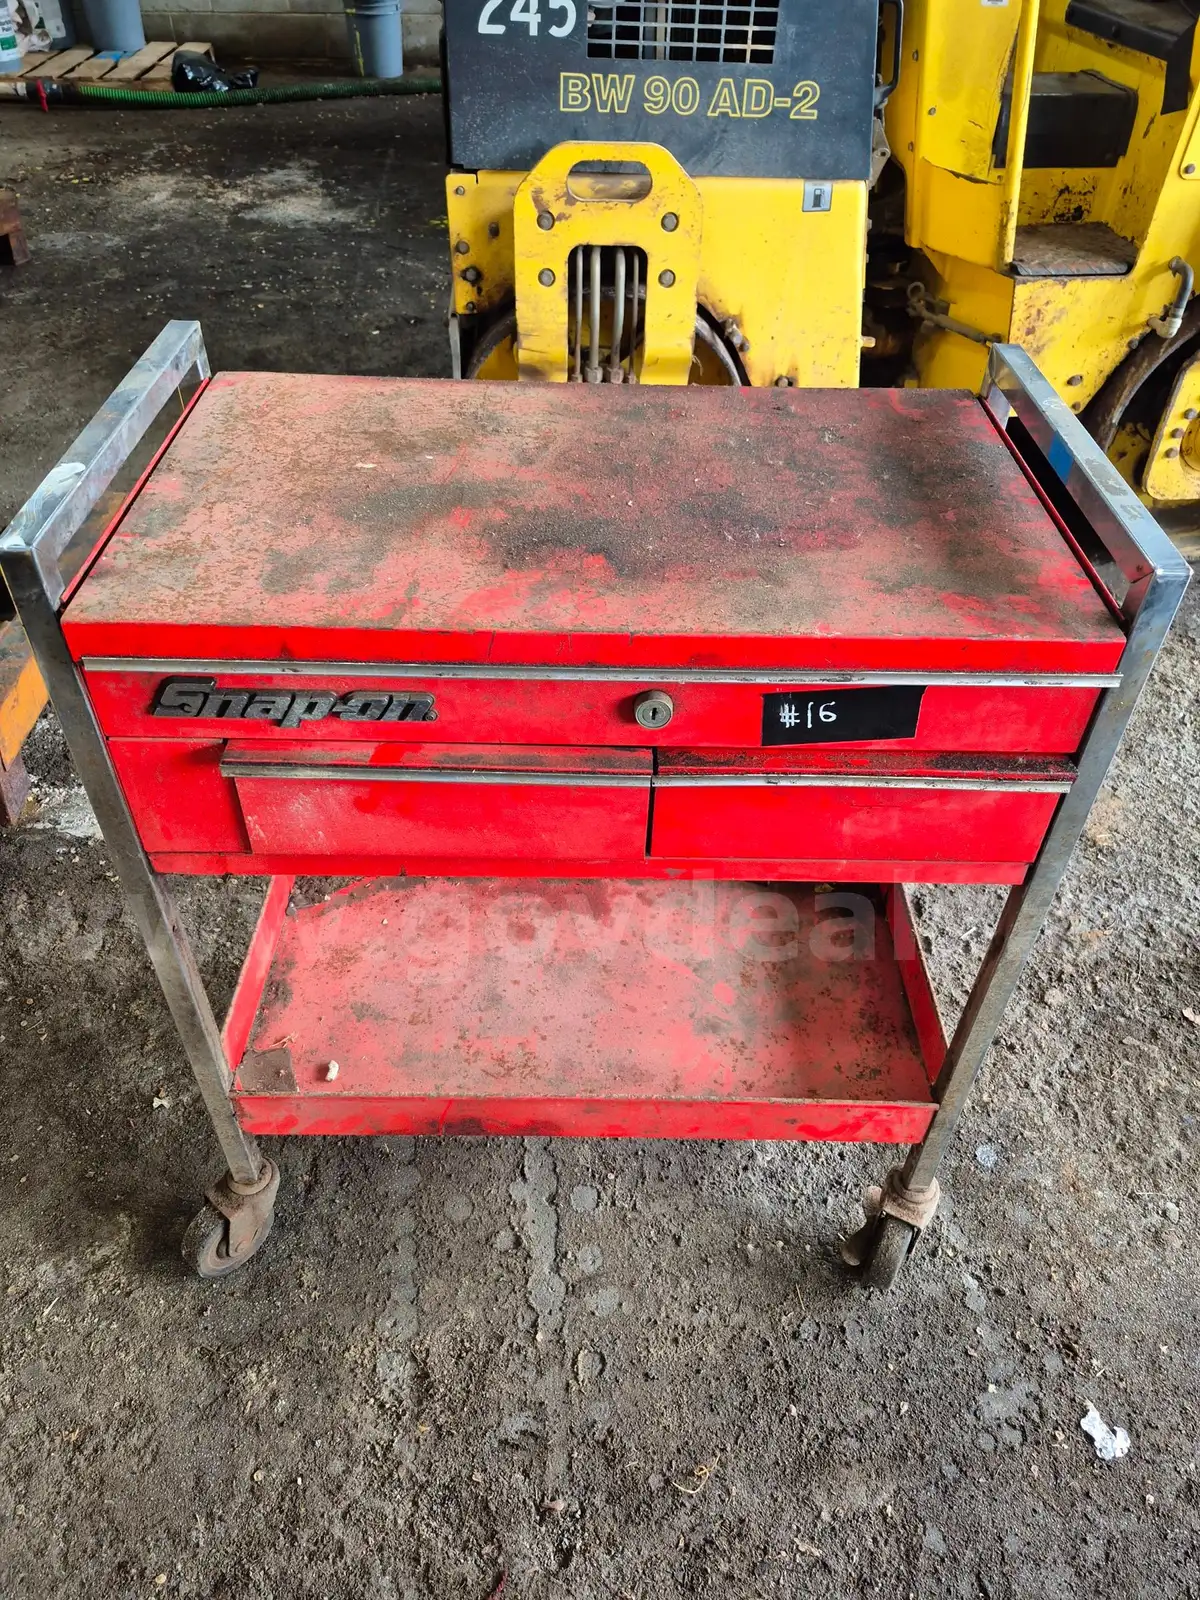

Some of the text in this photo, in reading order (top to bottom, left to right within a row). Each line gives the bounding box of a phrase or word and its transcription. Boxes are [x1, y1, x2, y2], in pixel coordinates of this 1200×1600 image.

[477, 0, 577, 38] 245
[559, 72, 821, 120] BW 90 AD-2
[779, 701, 837, 728] #16
